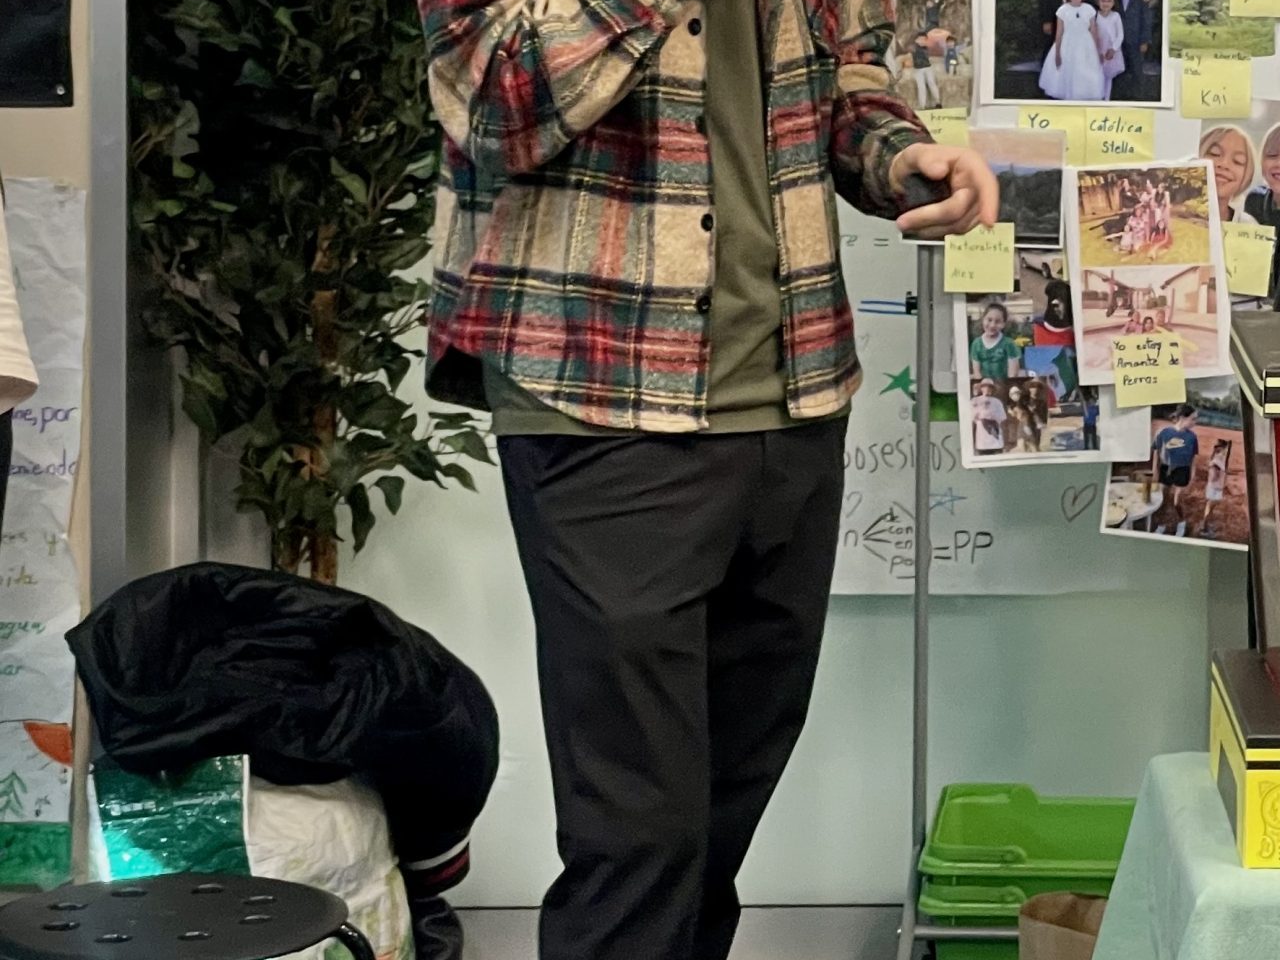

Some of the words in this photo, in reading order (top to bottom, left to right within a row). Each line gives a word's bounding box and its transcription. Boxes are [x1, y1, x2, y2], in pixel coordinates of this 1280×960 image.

[1201, 86, 1227, 107] Kai
[1028, 113, 1050, 129] Yo
[1089, 116, 1143, 134] Católica
[1101, 140, 1135, 154] Stella
[1113, 341, 1126, 351] Yo
